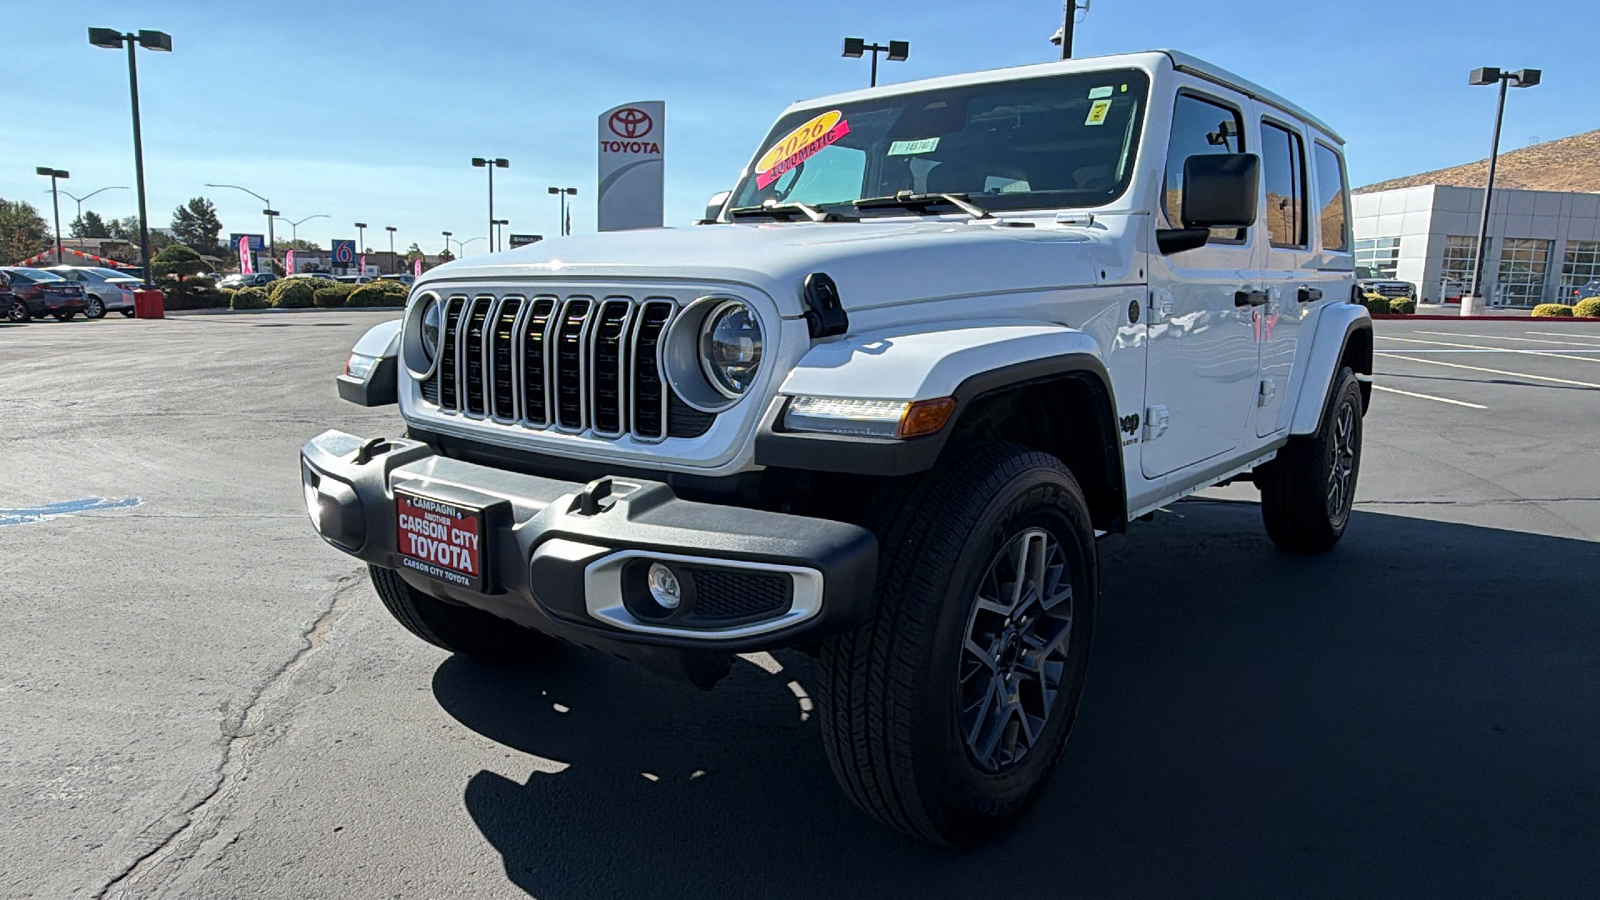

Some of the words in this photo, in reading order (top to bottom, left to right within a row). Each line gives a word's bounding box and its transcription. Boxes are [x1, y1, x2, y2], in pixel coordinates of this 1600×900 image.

[600, 141, 661, 154] TOYOTA
[773, 116, 826, 166] 2026
[769, 129, 837, 180] AUTOMATIC
[336, 241, 353, 263] 6
[1119, 413, 1140, 436] ep
[412, 497, 456, 517] CAMPAGNI
[424, 512, 451, 527] ANOTHER
[399, 513, 448, 541] CARSON
[451, 528, 478, 550] CITY
[407, 532, 474, 573] TOYOTA
[403, 558, 429, 573] CARSON
[429, 566, 444, 578] CITY
[444, 571, 470, 587] TOYOTA
